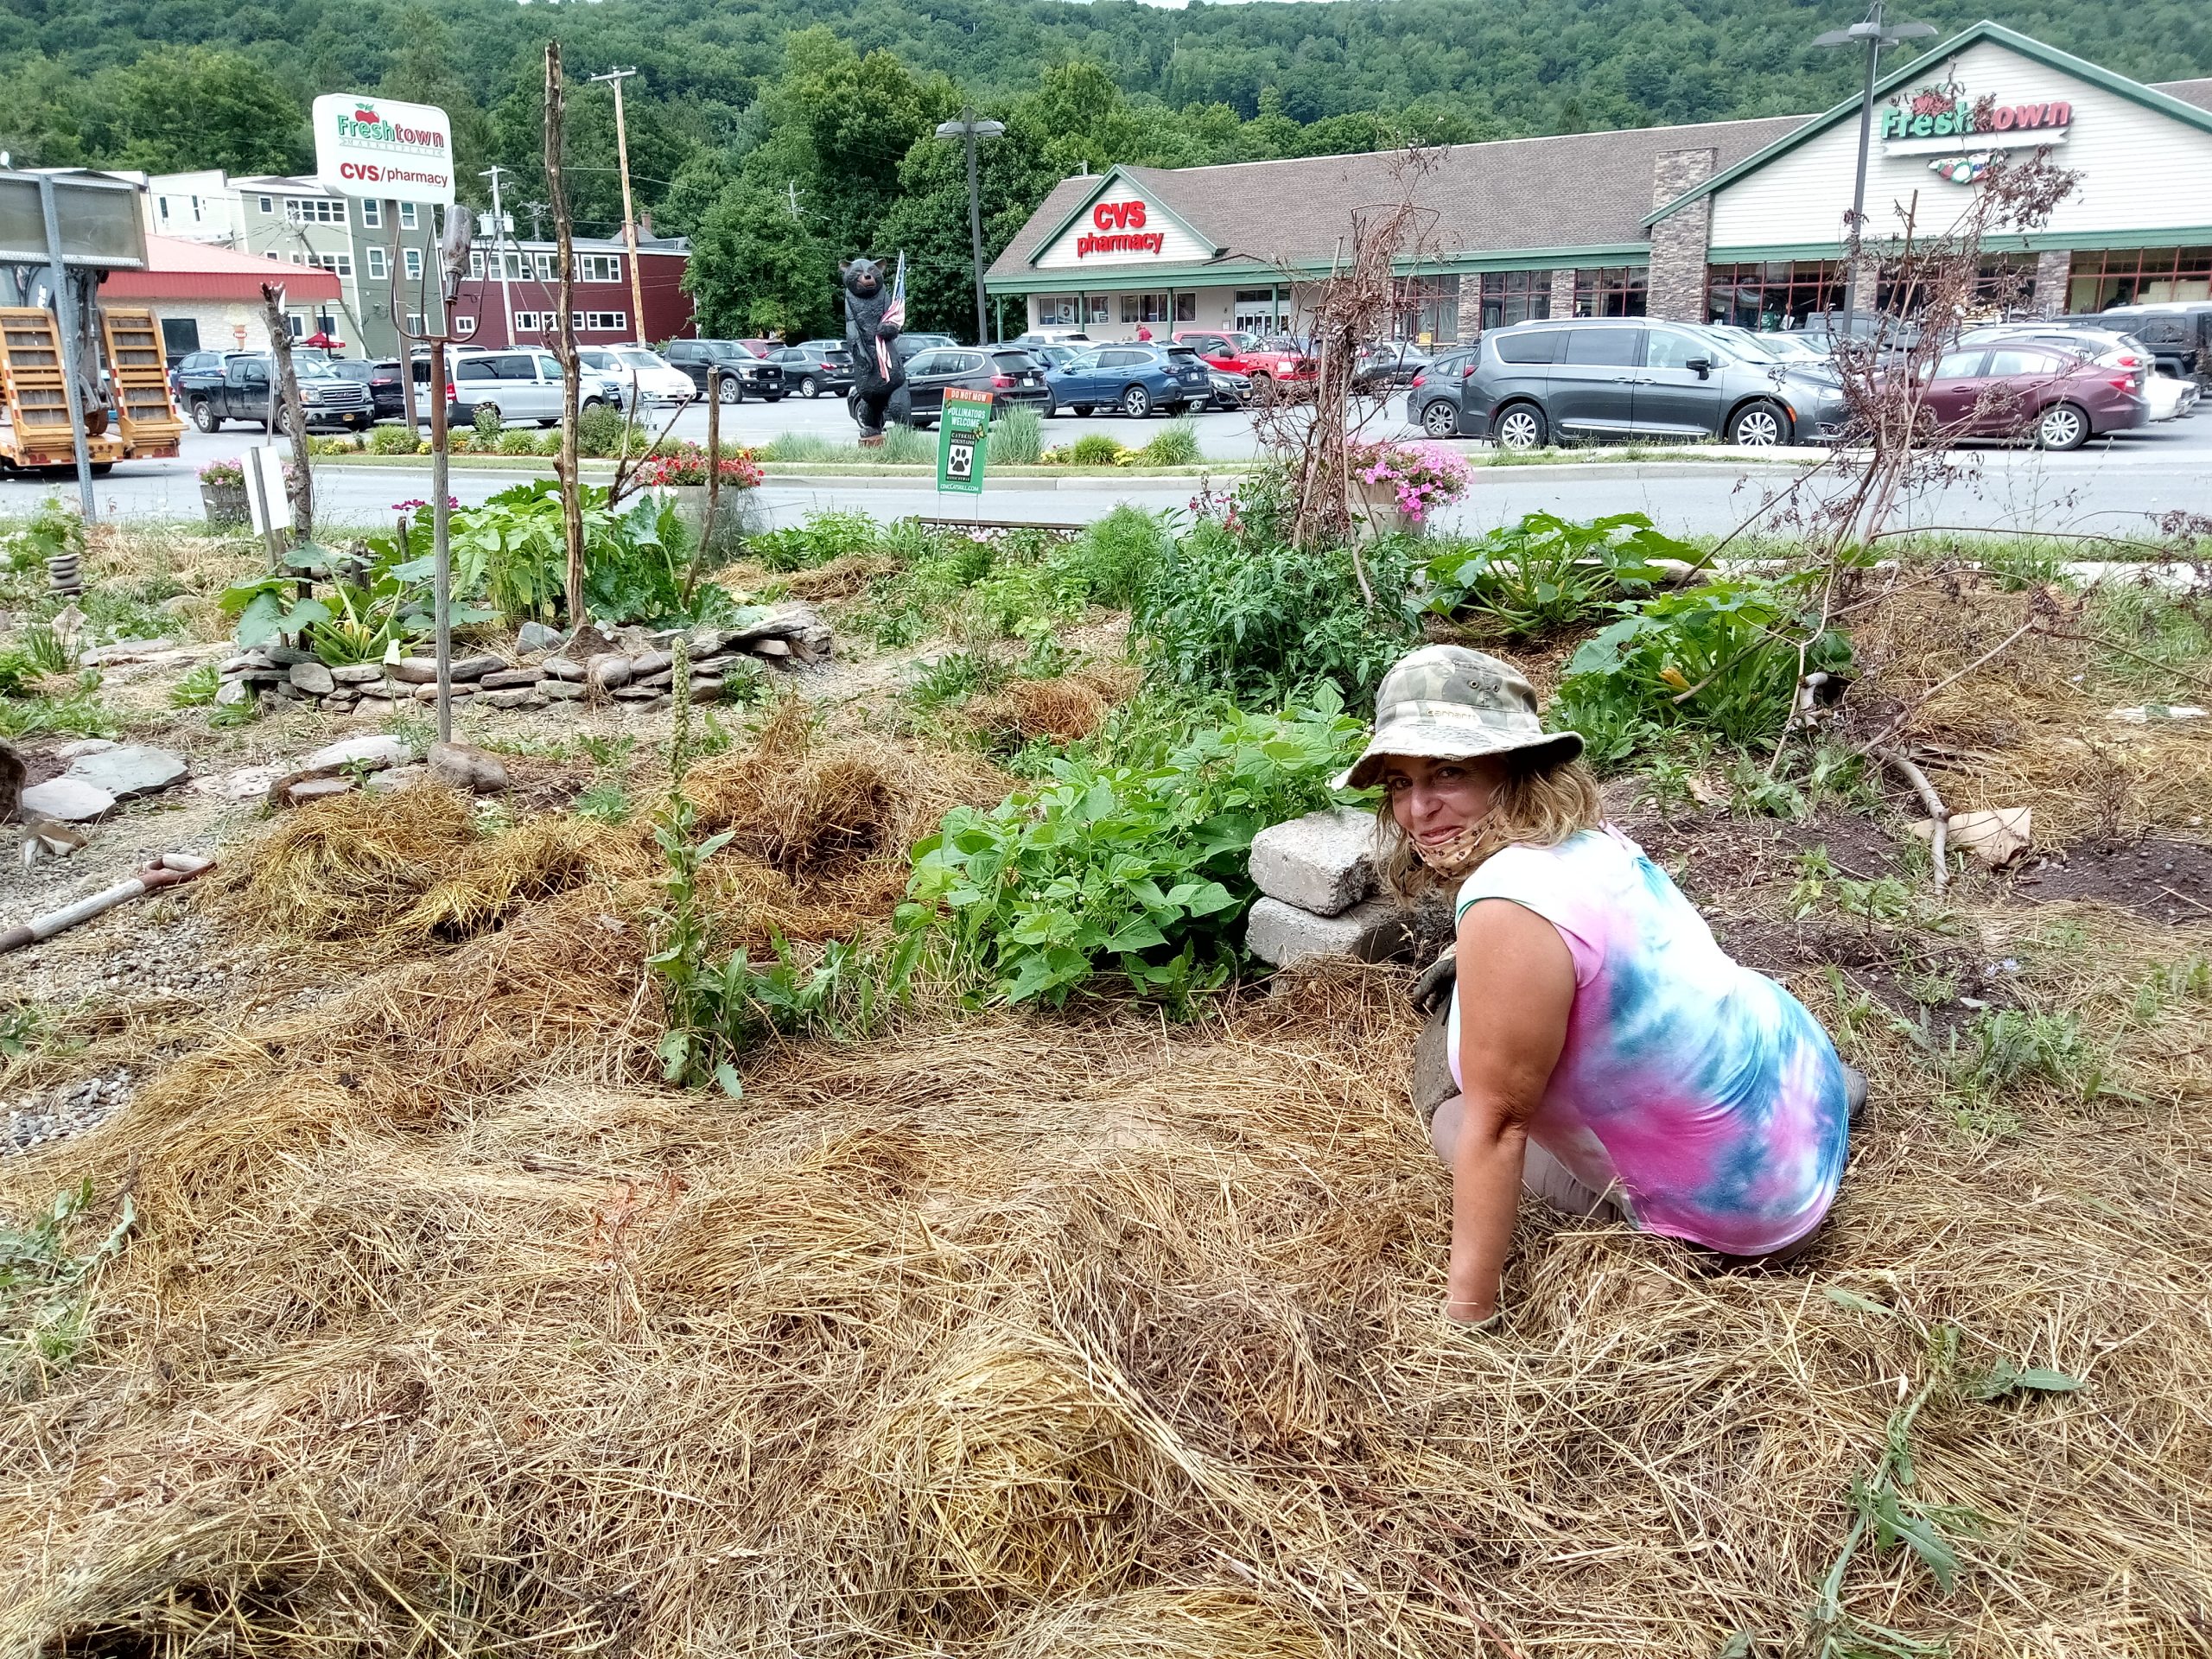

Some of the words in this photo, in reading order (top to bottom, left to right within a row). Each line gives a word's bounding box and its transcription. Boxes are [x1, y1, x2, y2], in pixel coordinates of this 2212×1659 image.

[337, 115, 444, 148] Freshtown
[1881, 101, 2073, 140] Freshown
[347, 139, 436, 156] MARKETPLACE
[340, 162, 448, 188] CVS/pharmacy
[1094, 200, 1147, 230] CVS
[1077, 232, 1164, 258] pharmacy
[951, 390, 960, 398] DO
[960, 391, 972, 400] NOT
[972, 393, 987, 402] MOW
[947, 407, 986, 419] POLLINATORS
[951, 416, 980, 428] WELCOME
